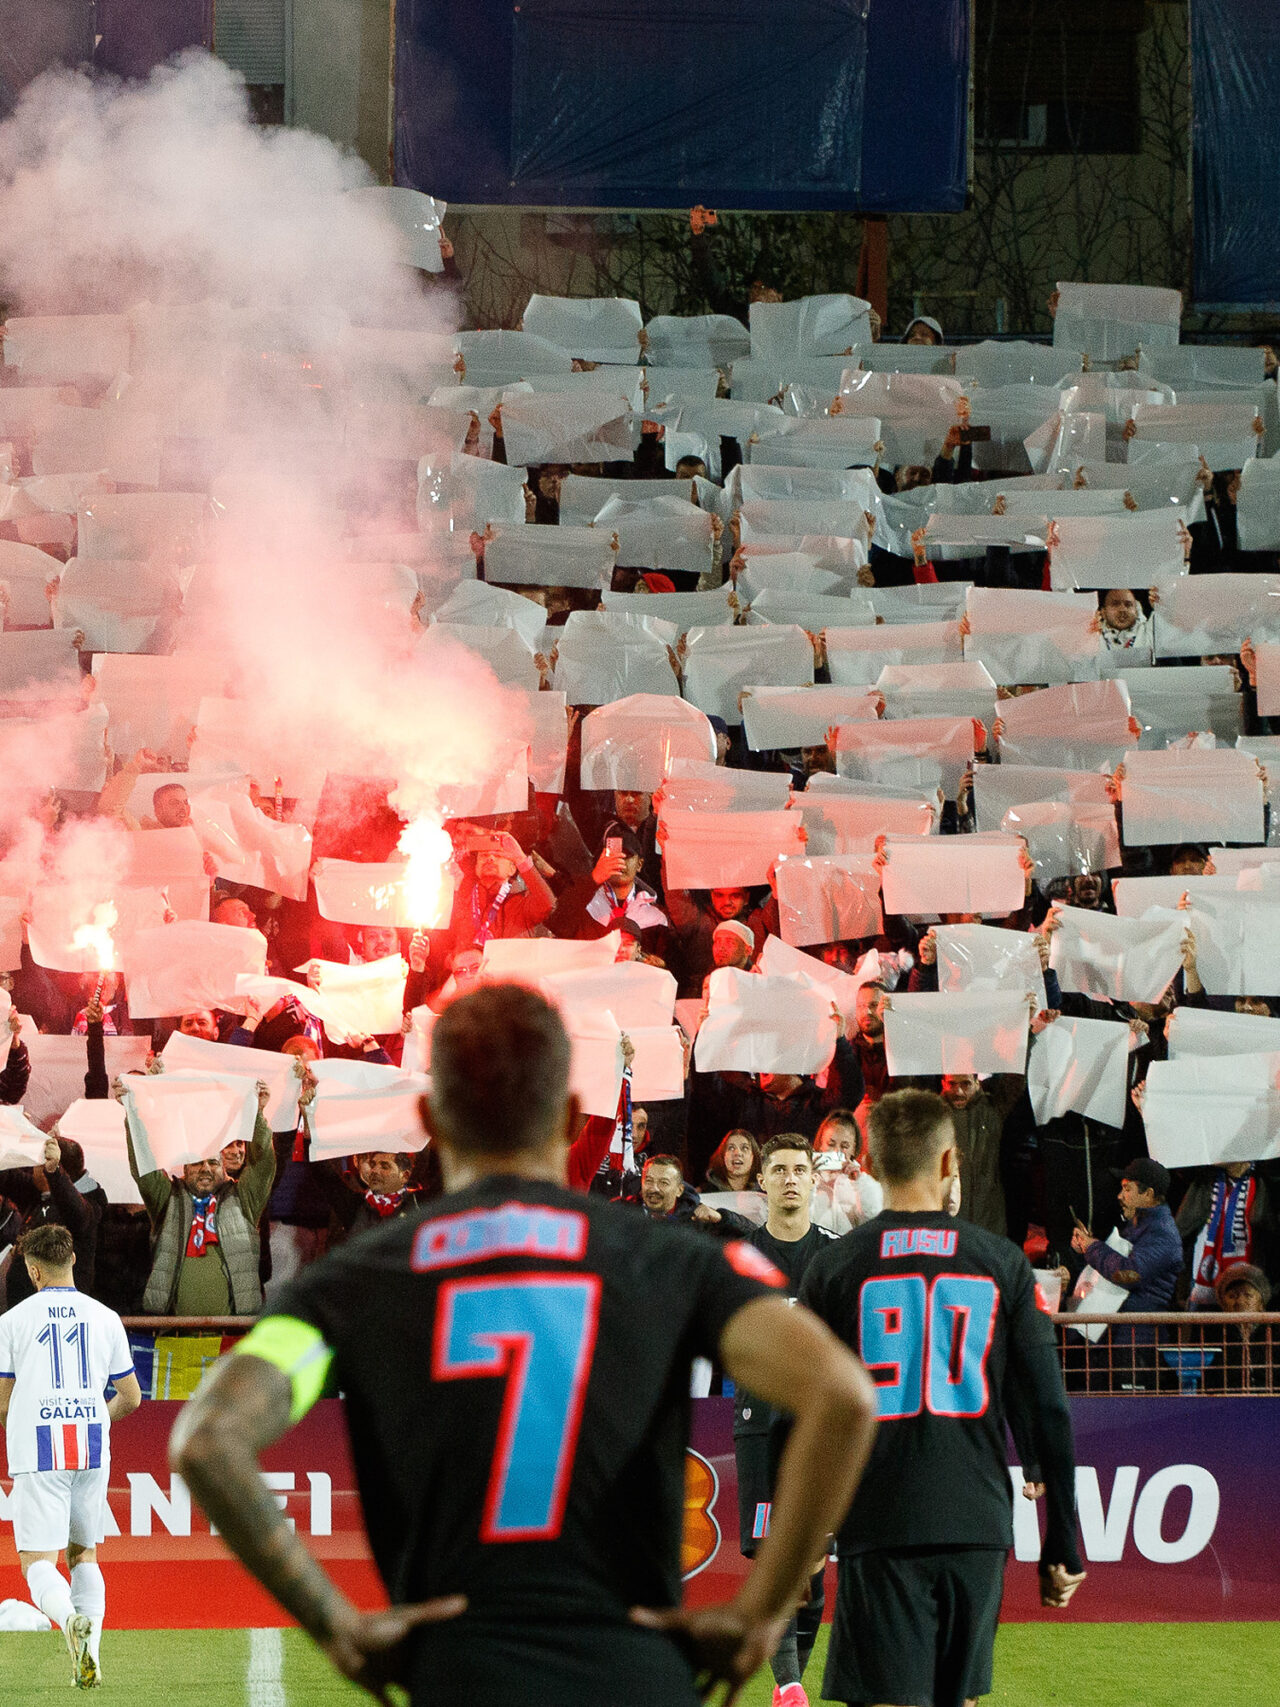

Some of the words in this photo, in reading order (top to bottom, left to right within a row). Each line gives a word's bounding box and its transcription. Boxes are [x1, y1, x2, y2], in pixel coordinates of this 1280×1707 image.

[880, 1228, 959, 1259] RUSU
[48, 1307, 76, 1318] NICA
[35, 1322, 92, 1389] 11
[858, 1273, 1000, 1420] 90
[431, 1271, 603, 1545] 7
